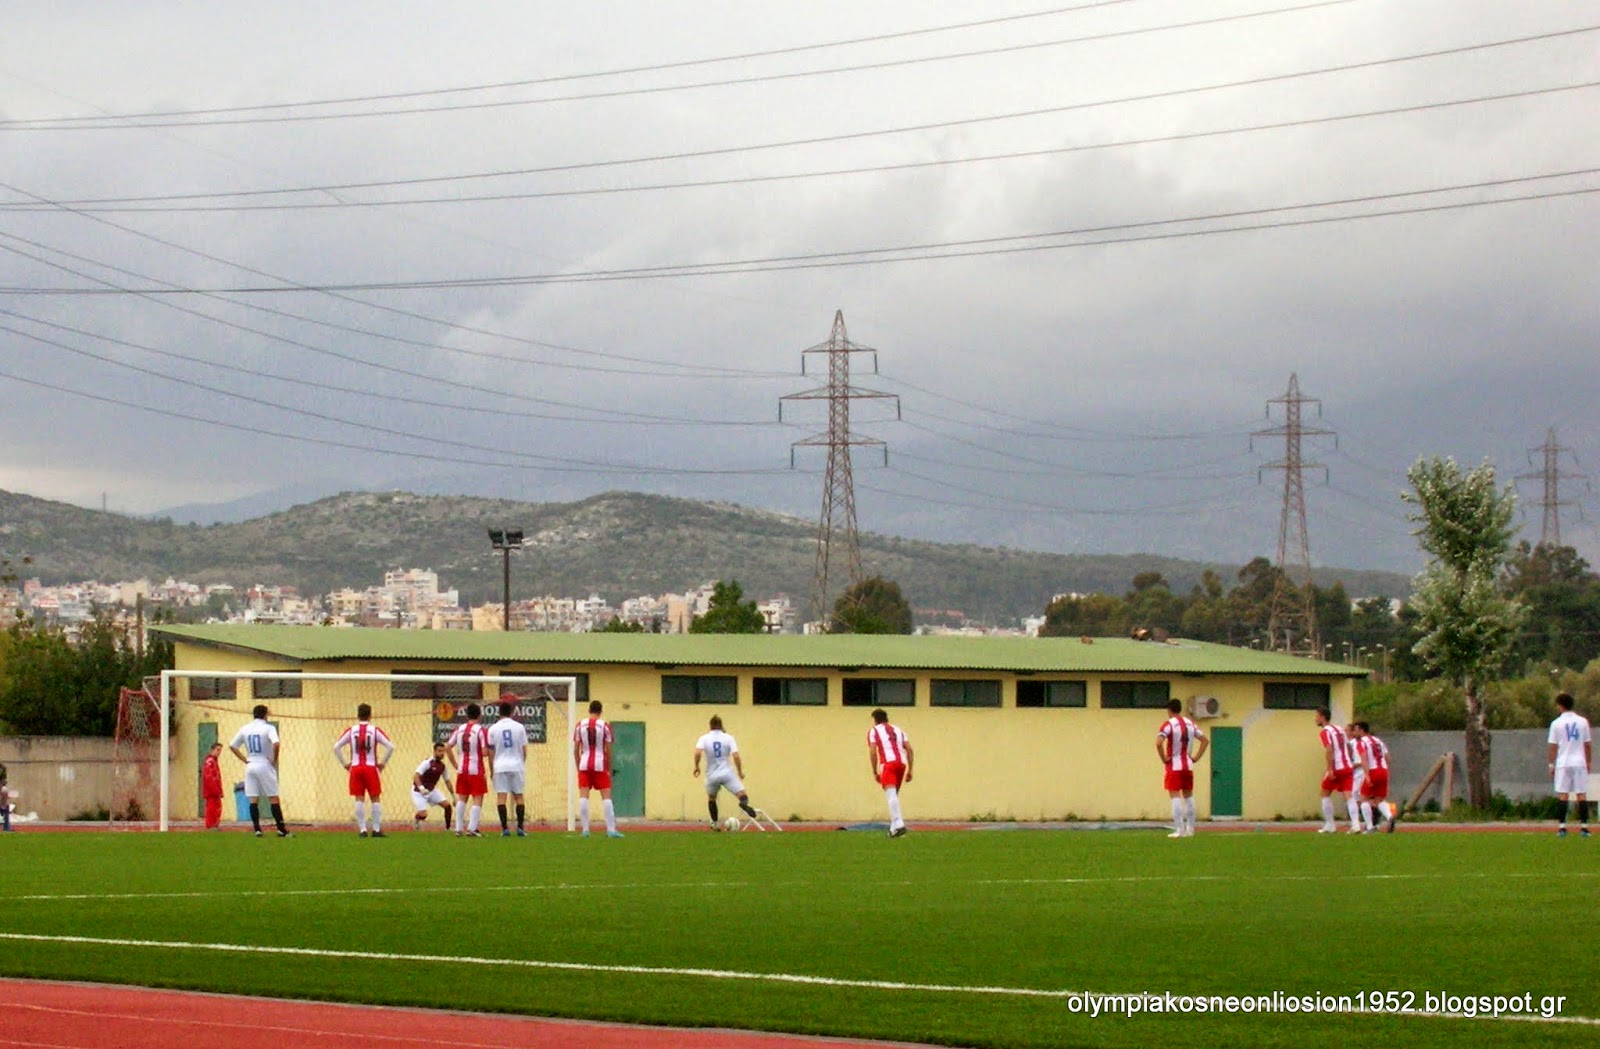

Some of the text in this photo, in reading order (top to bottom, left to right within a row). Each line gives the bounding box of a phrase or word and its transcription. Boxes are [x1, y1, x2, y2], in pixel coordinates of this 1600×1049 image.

[512, 705, 543, 717] ΛΙΟΥ
[502, 730, 513, 748] 9
[1565, 722, 1580, 742] 14
[247, 734, 262, 753] 10
[712, 741, 721, 758] 8
